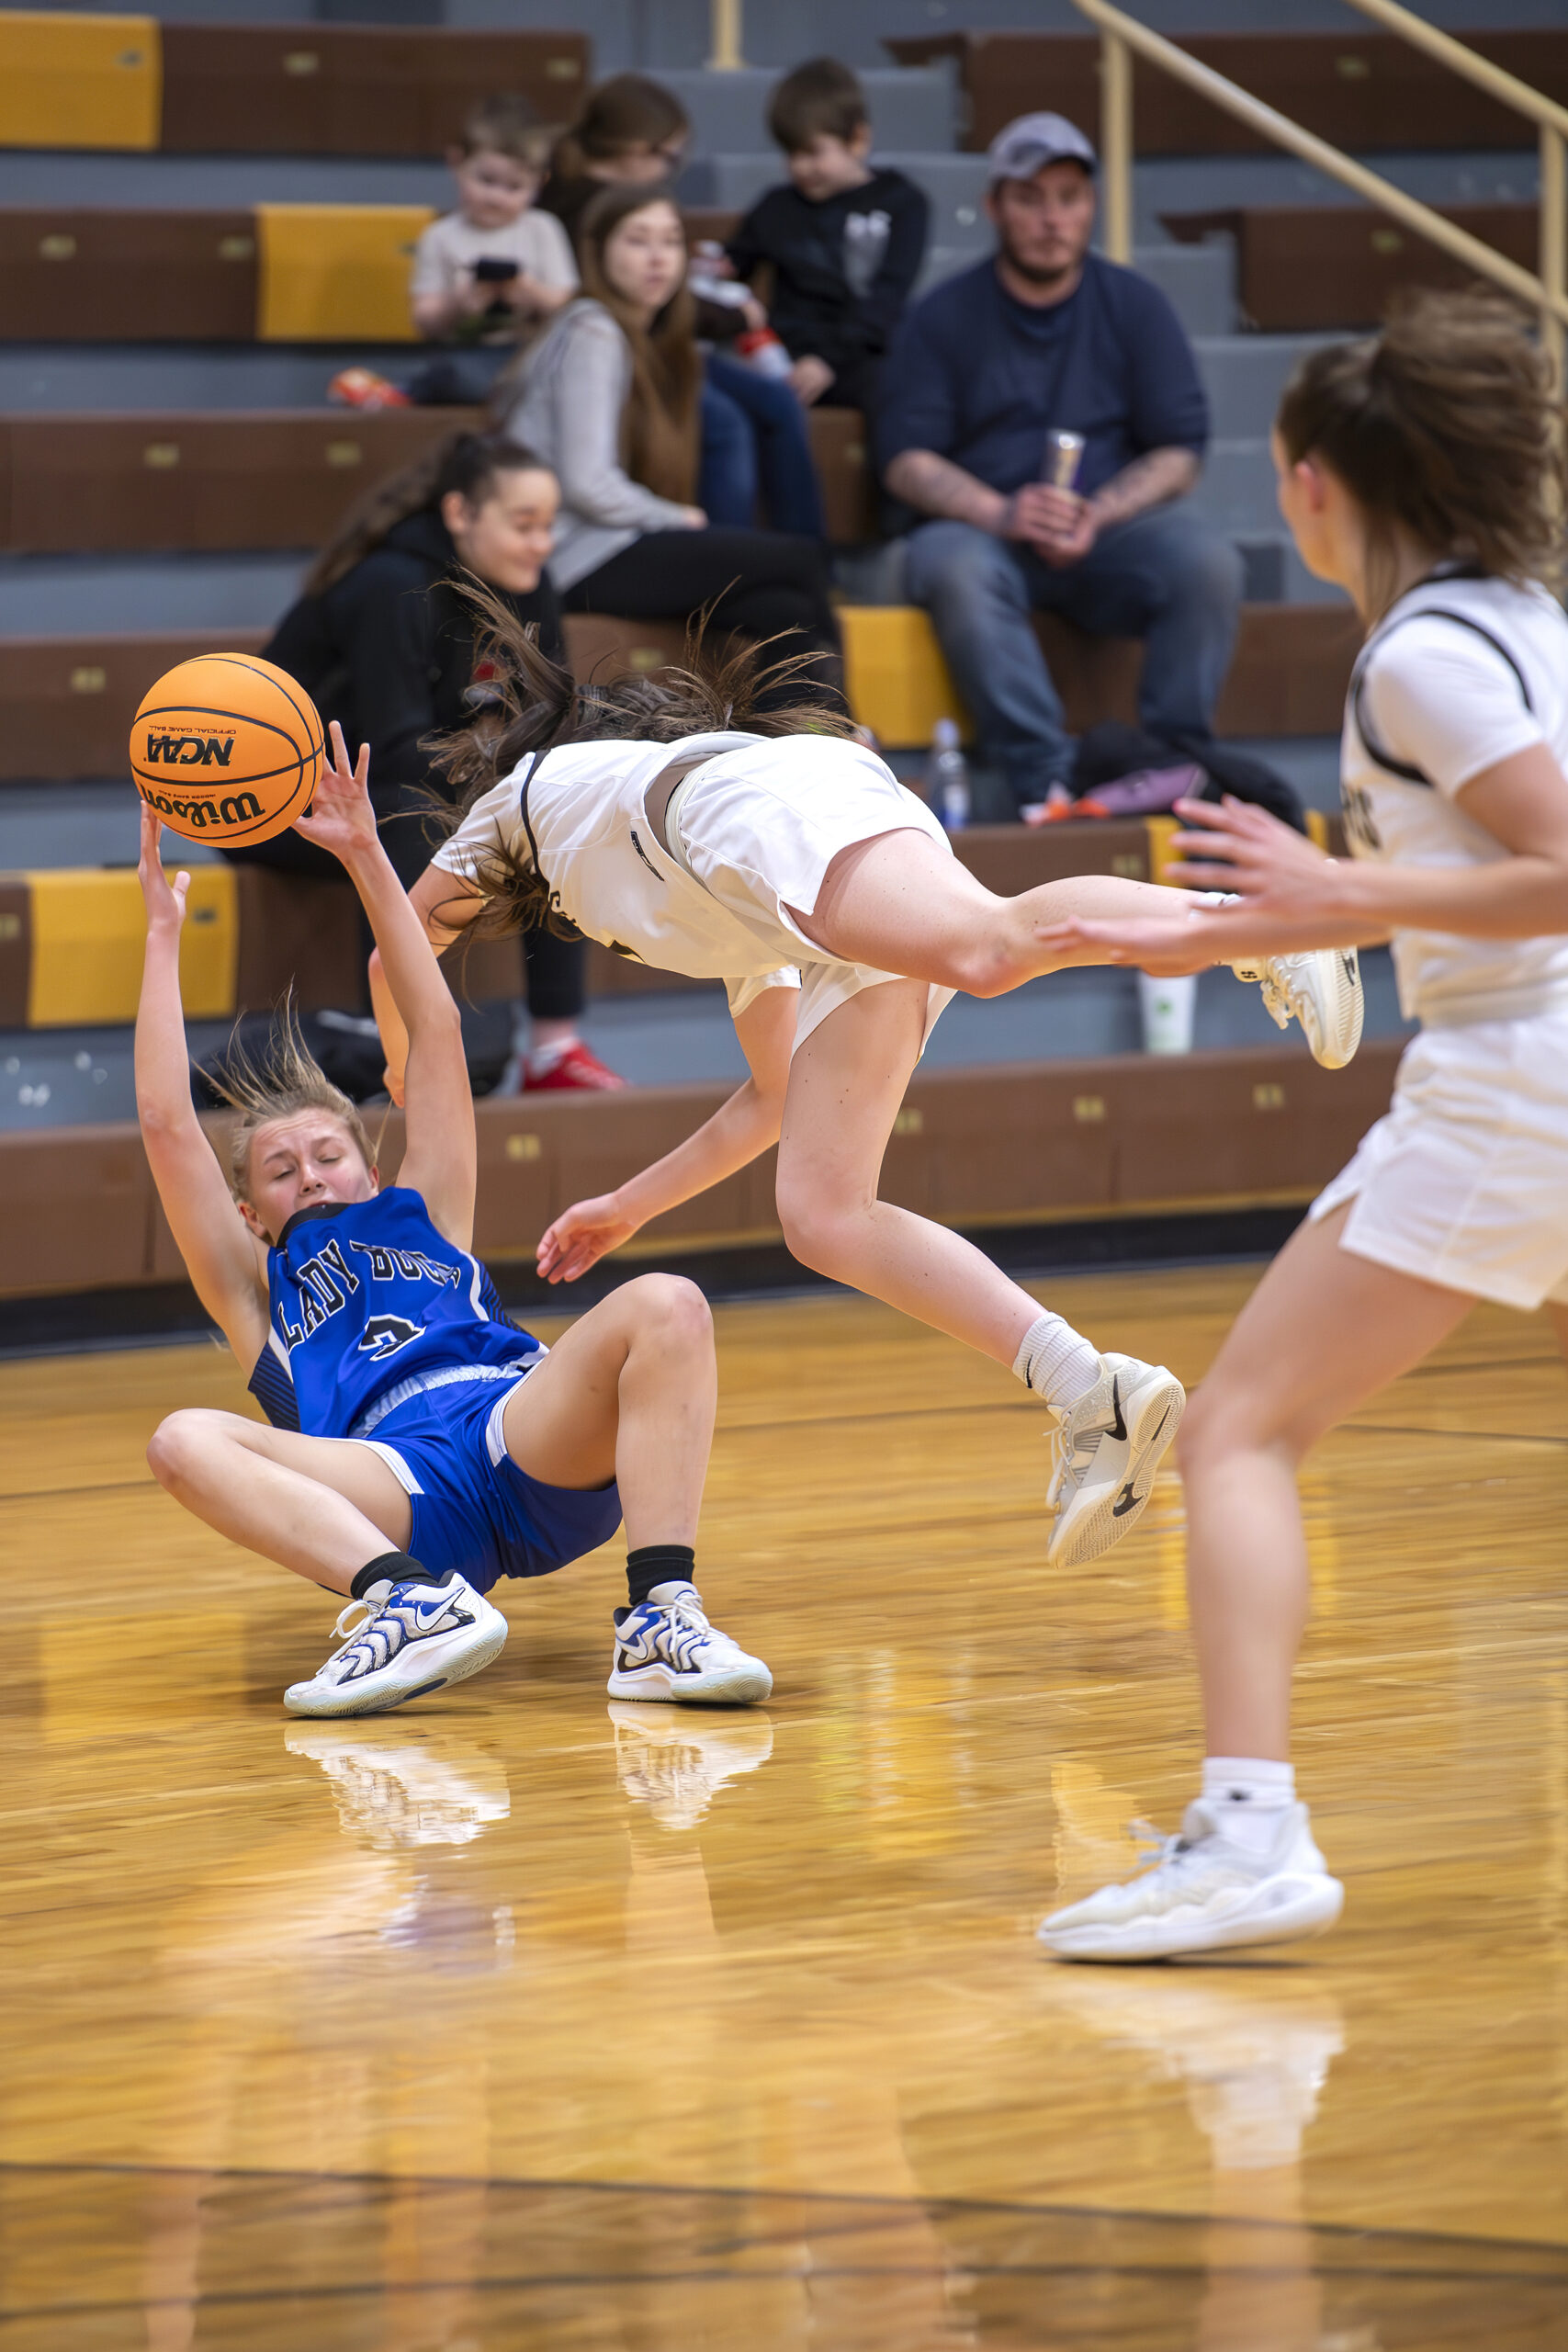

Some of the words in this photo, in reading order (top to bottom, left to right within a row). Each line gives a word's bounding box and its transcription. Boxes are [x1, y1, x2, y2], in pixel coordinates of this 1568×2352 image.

[147, 733, 235, 767] NCAA
[140, 784, 266, 828] Wilson
[278, 1238, 360, 1356] LADY
